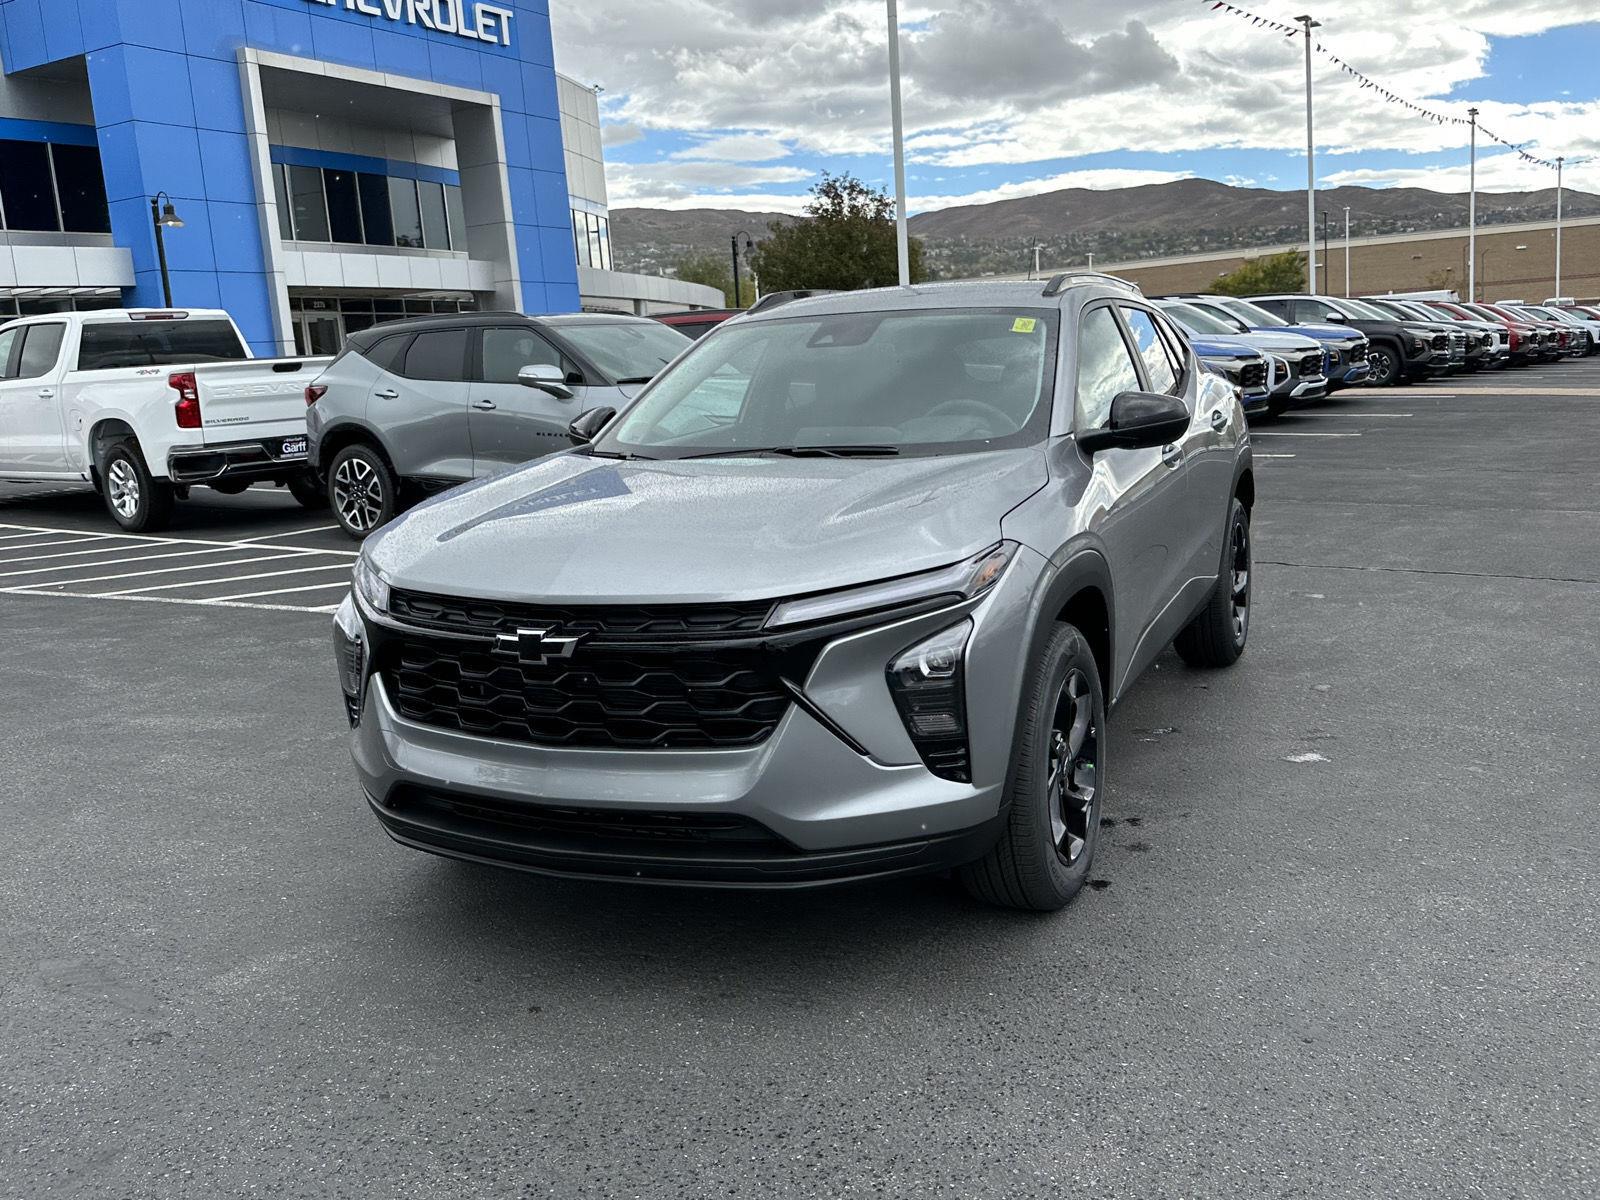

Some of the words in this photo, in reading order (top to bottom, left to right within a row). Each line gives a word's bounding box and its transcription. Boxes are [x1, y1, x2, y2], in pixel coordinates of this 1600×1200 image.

[312, 0, 513, 46] VROLET
[212, 382, 308, 397] CHEVR
[204, 417, 250, 425] SILVERADO
[282, 441, 306, 454] Garff
